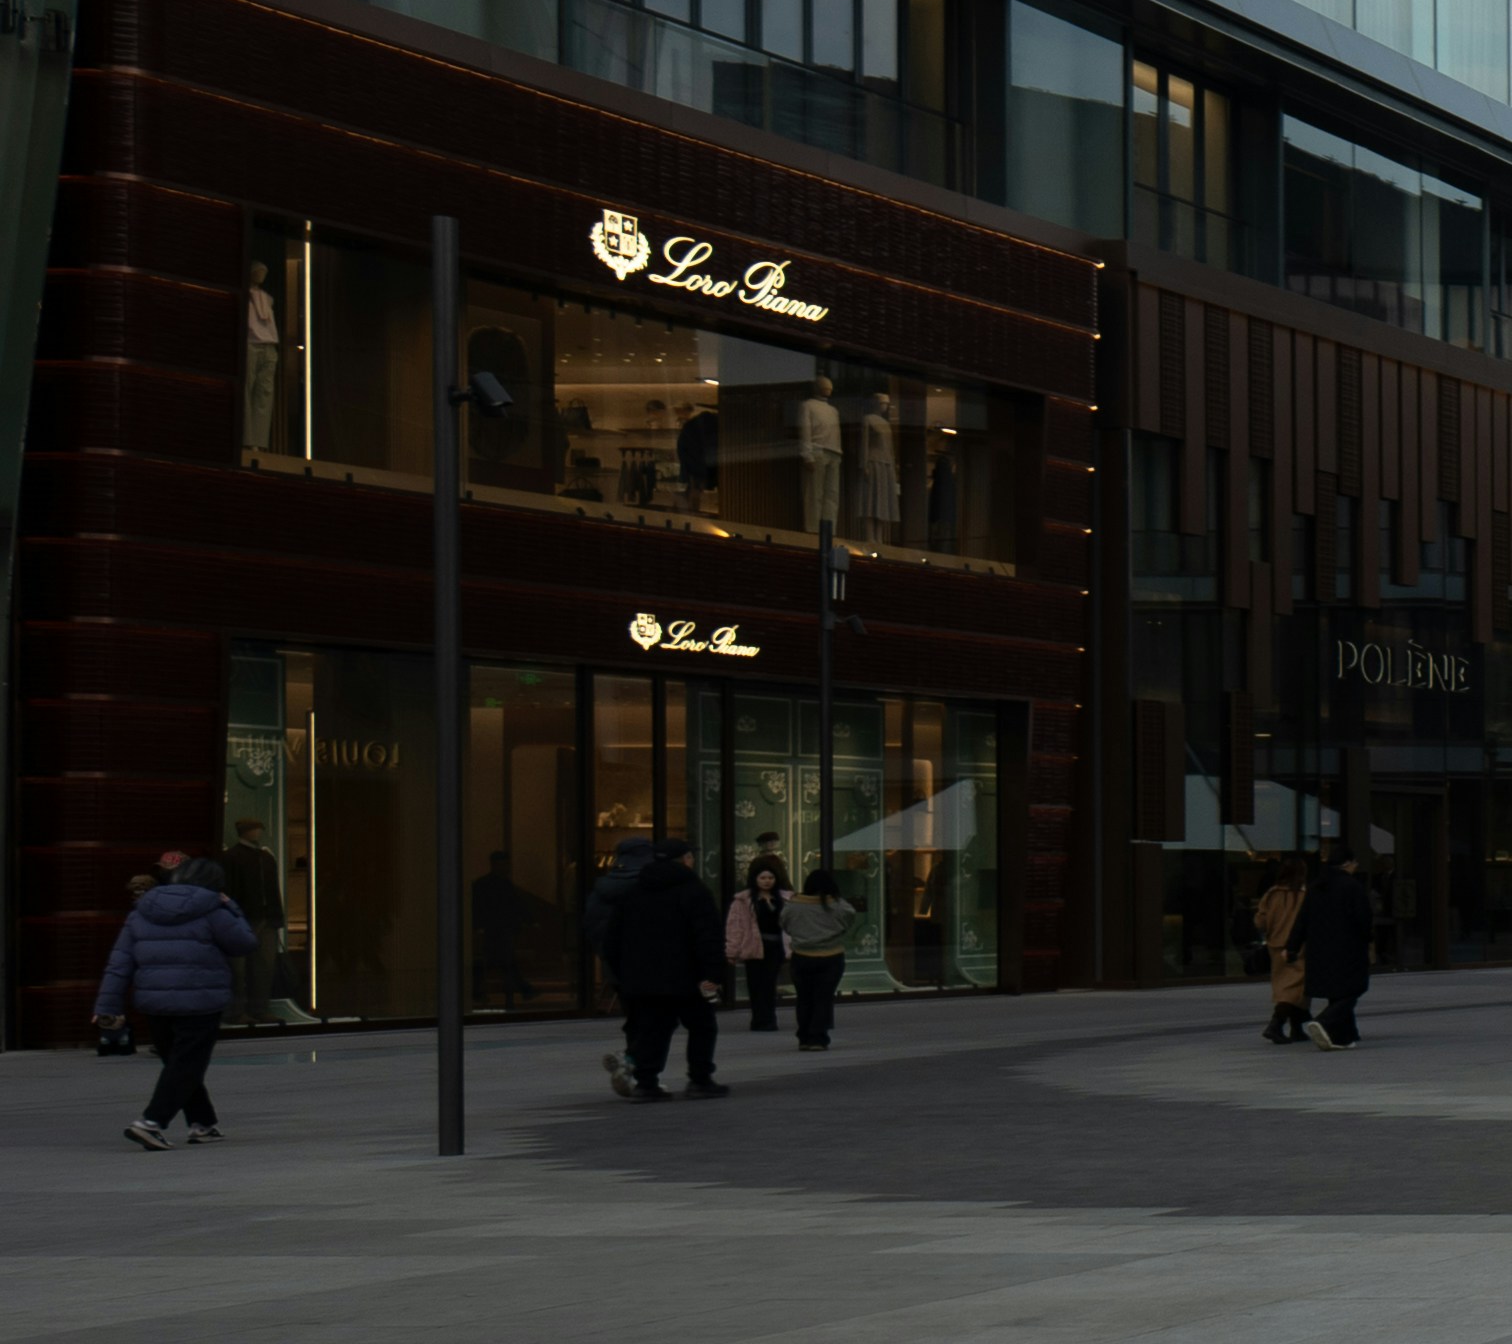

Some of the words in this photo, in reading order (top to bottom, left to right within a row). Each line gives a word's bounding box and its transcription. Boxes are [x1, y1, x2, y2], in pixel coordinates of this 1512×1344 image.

[648, 236, 738, 297] Loro
[738, 261, 829, 321] Piana
[660, 620, 709, 652] Loro
[709, 625, 760, 657] Piana
